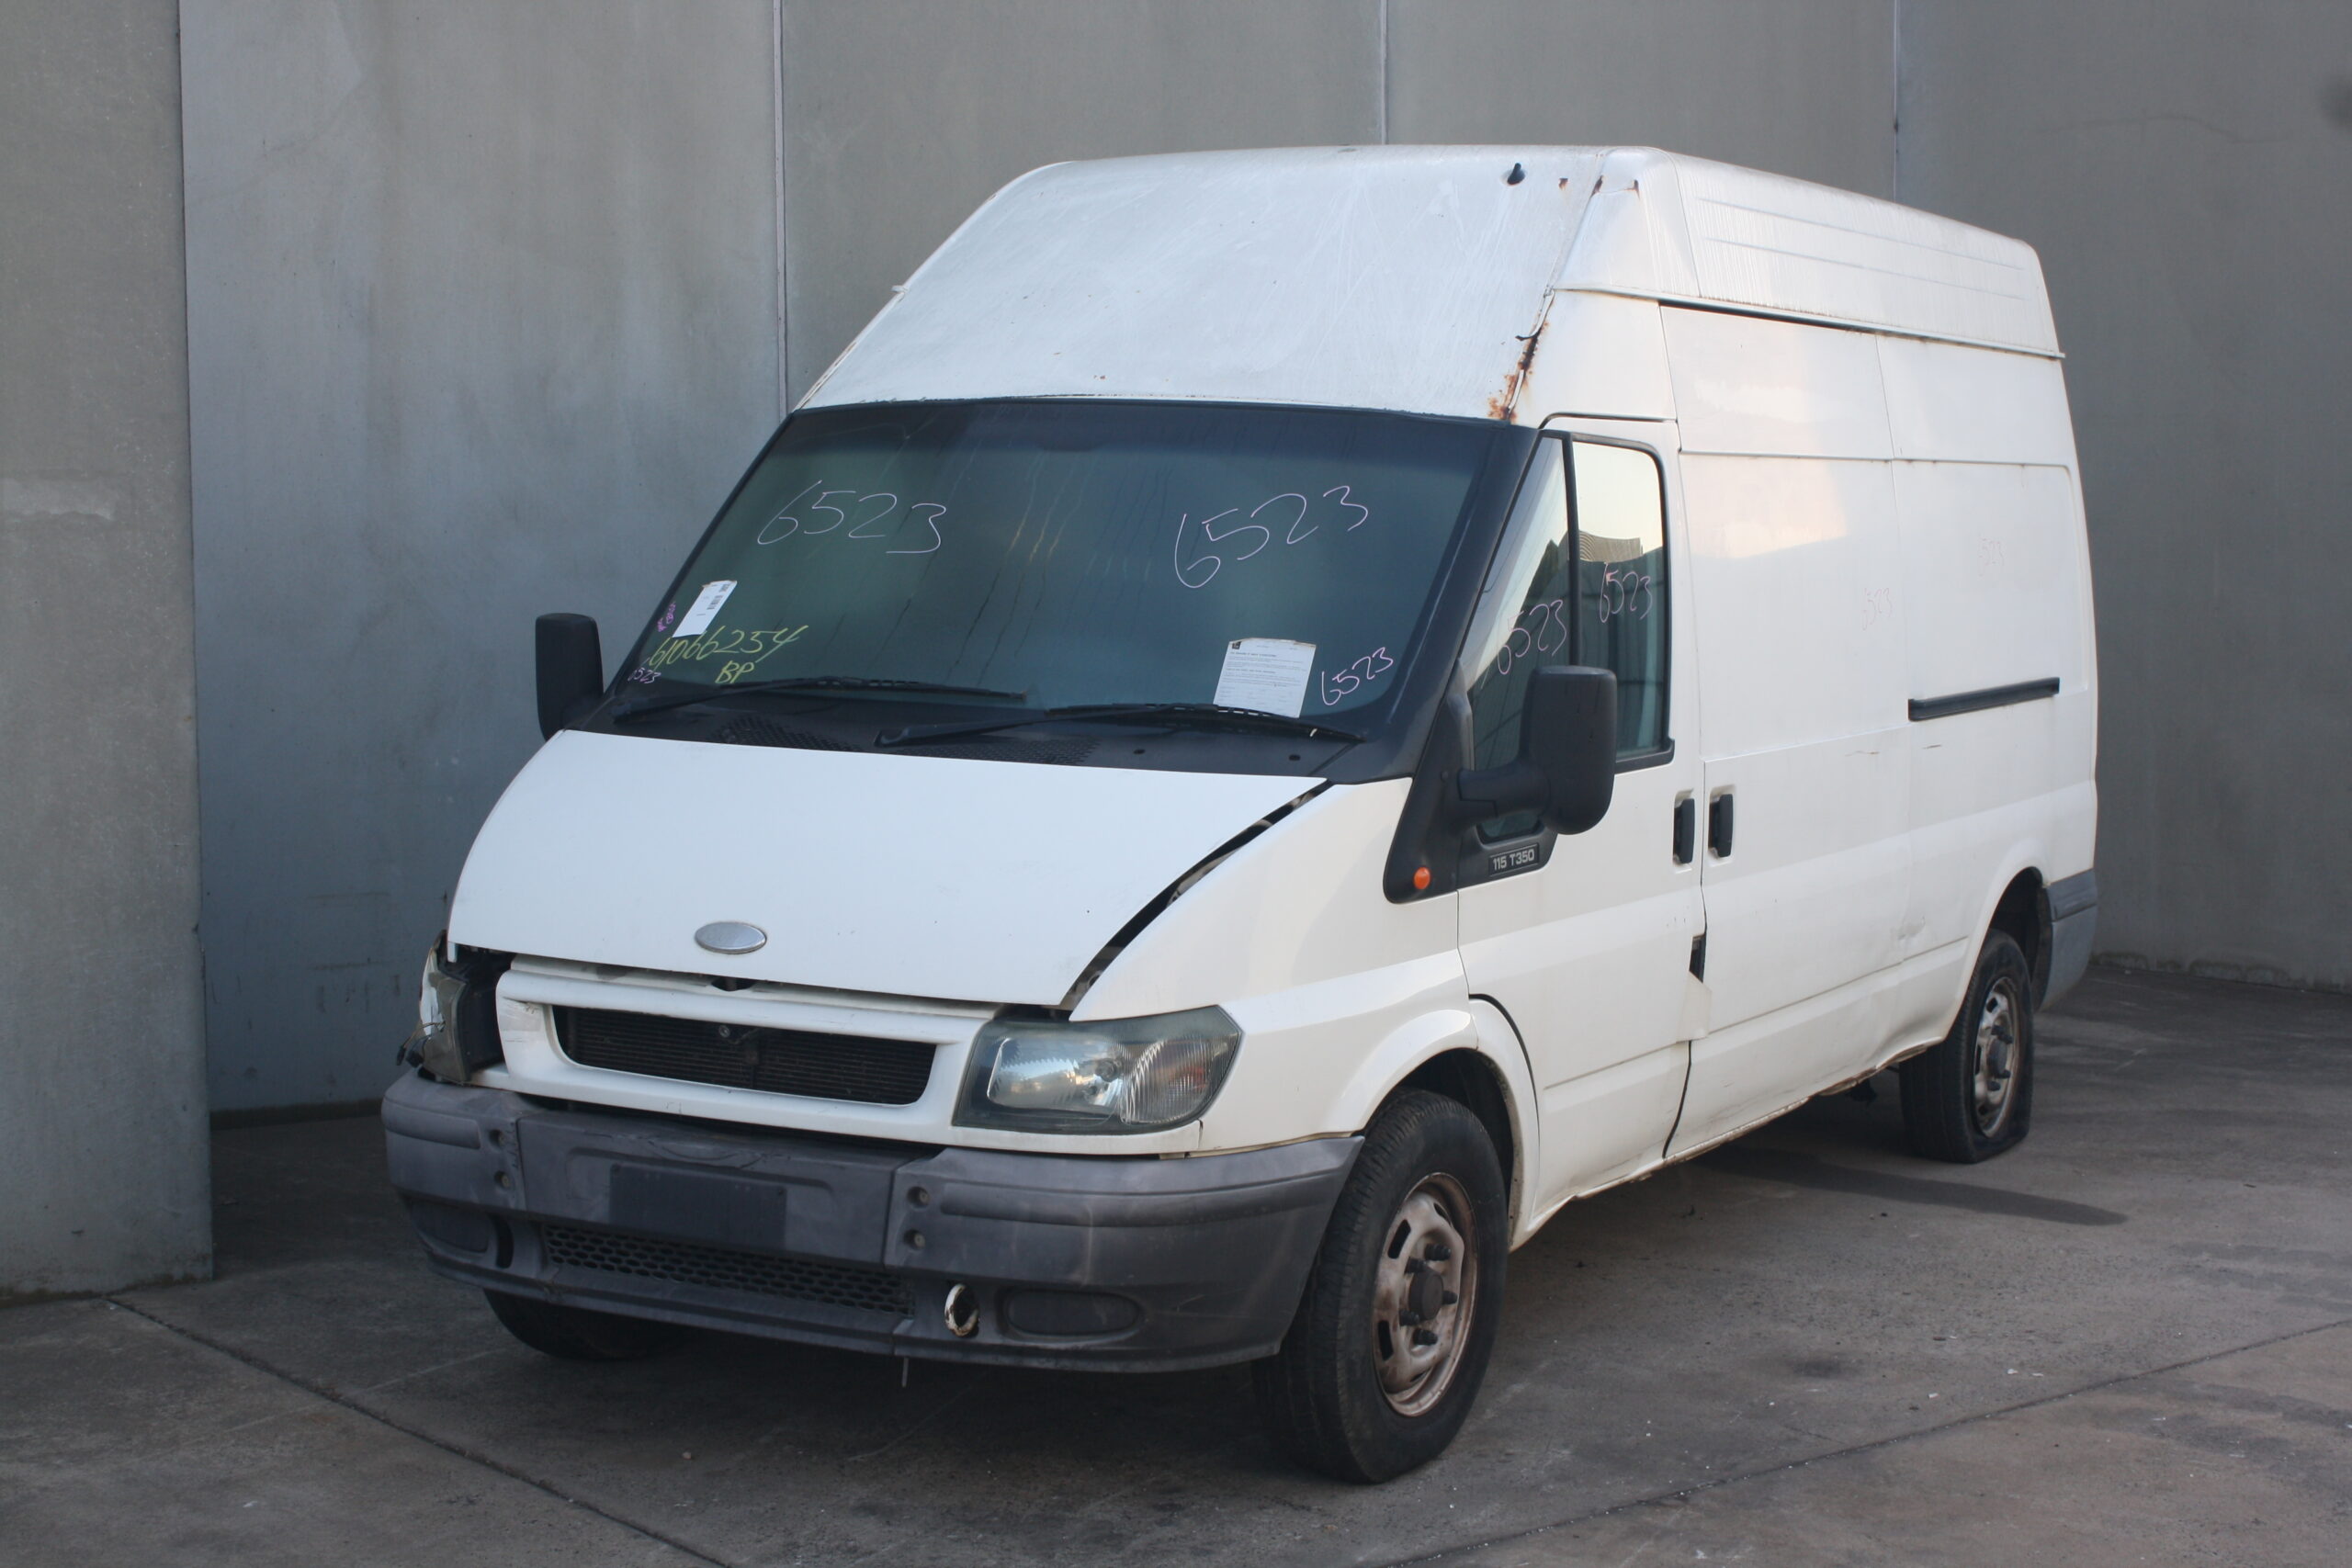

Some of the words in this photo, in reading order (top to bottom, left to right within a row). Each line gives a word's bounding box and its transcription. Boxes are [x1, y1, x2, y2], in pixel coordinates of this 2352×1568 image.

[757, 479, 946, 554] 6523
[1173, 485, 1369, 589] 6523
[1599, 562, 1653, 624] 6523
[715, 660, 754, 683] BP
[1320, 647, 1394, 705] 6523
[1492, 856, 1507, 871] 115
[1510, 848, 1535, 866] T350
